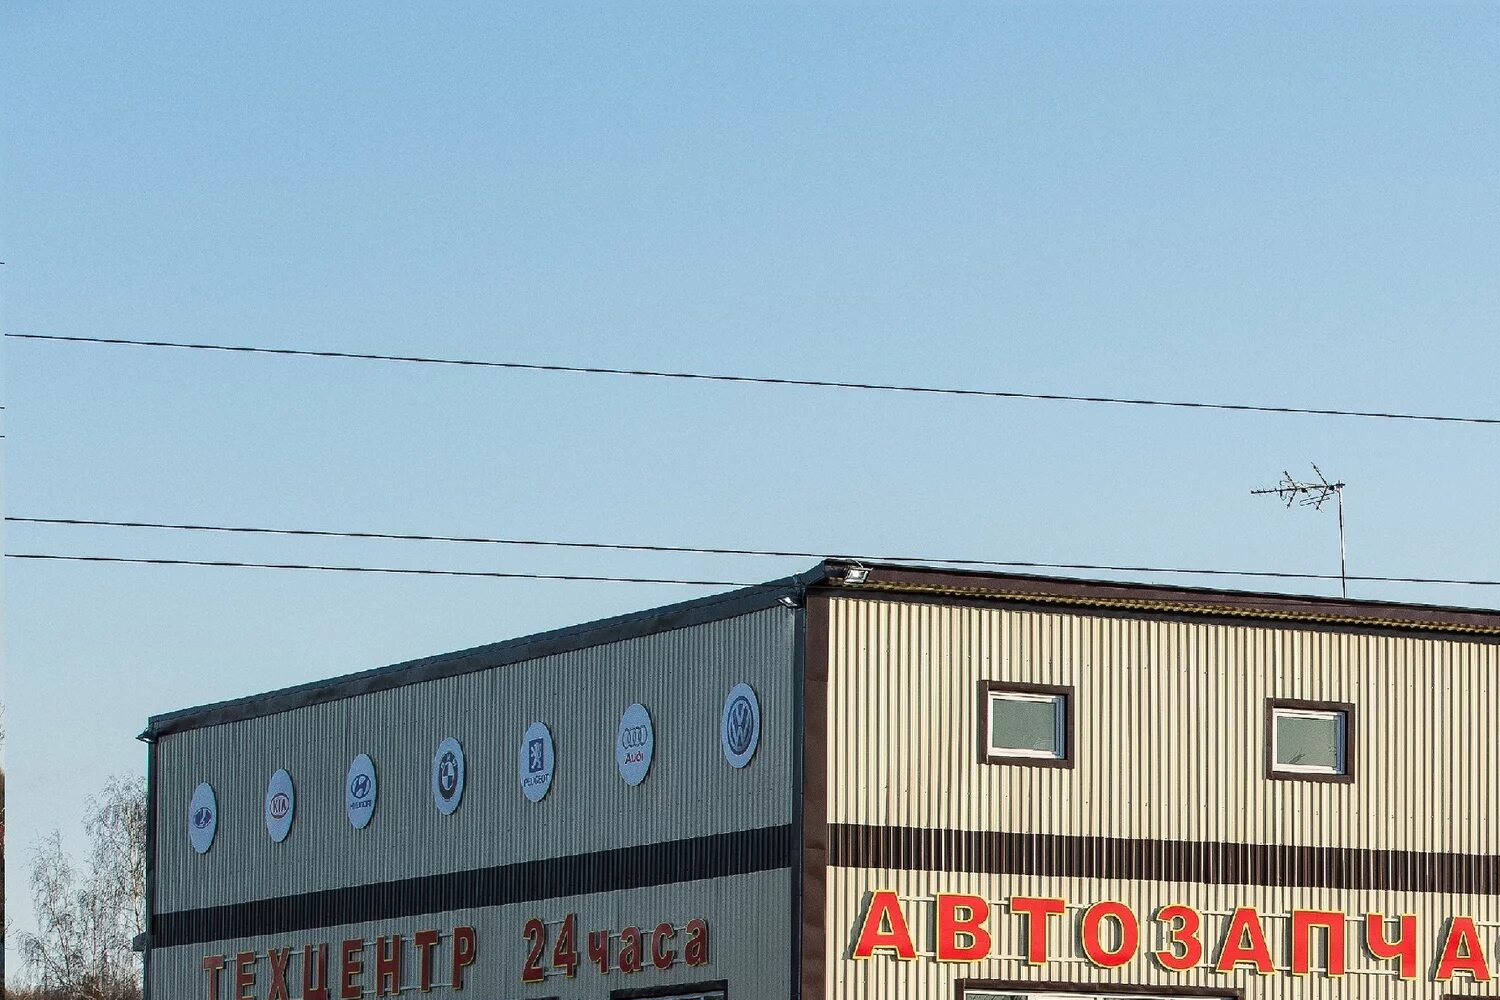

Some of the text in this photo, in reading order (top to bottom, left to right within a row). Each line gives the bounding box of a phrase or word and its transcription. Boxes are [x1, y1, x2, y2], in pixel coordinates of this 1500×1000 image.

[624, 752, 645, 765] Audi
[523, 773, 549, 787] PEUGEOT
[272, 798, 288, 814] KIA
